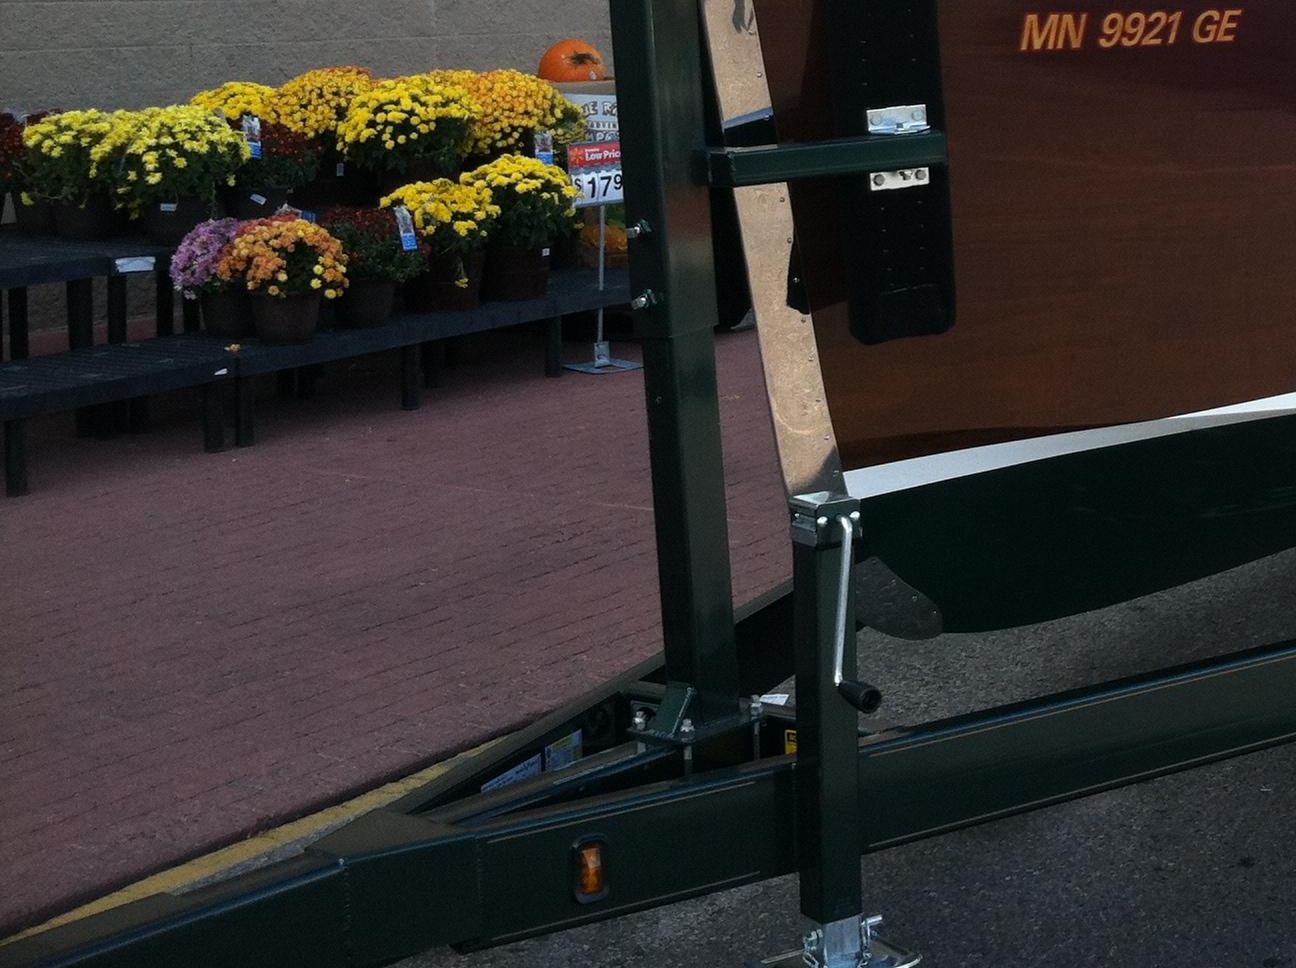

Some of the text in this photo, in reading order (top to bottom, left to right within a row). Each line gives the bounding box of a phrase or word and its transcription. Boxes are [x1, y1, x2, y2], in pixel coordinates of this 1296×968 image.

[1020, 7, 1242, 51] MN 9921 GE
[586, 149, 621, 162] Low Pric
